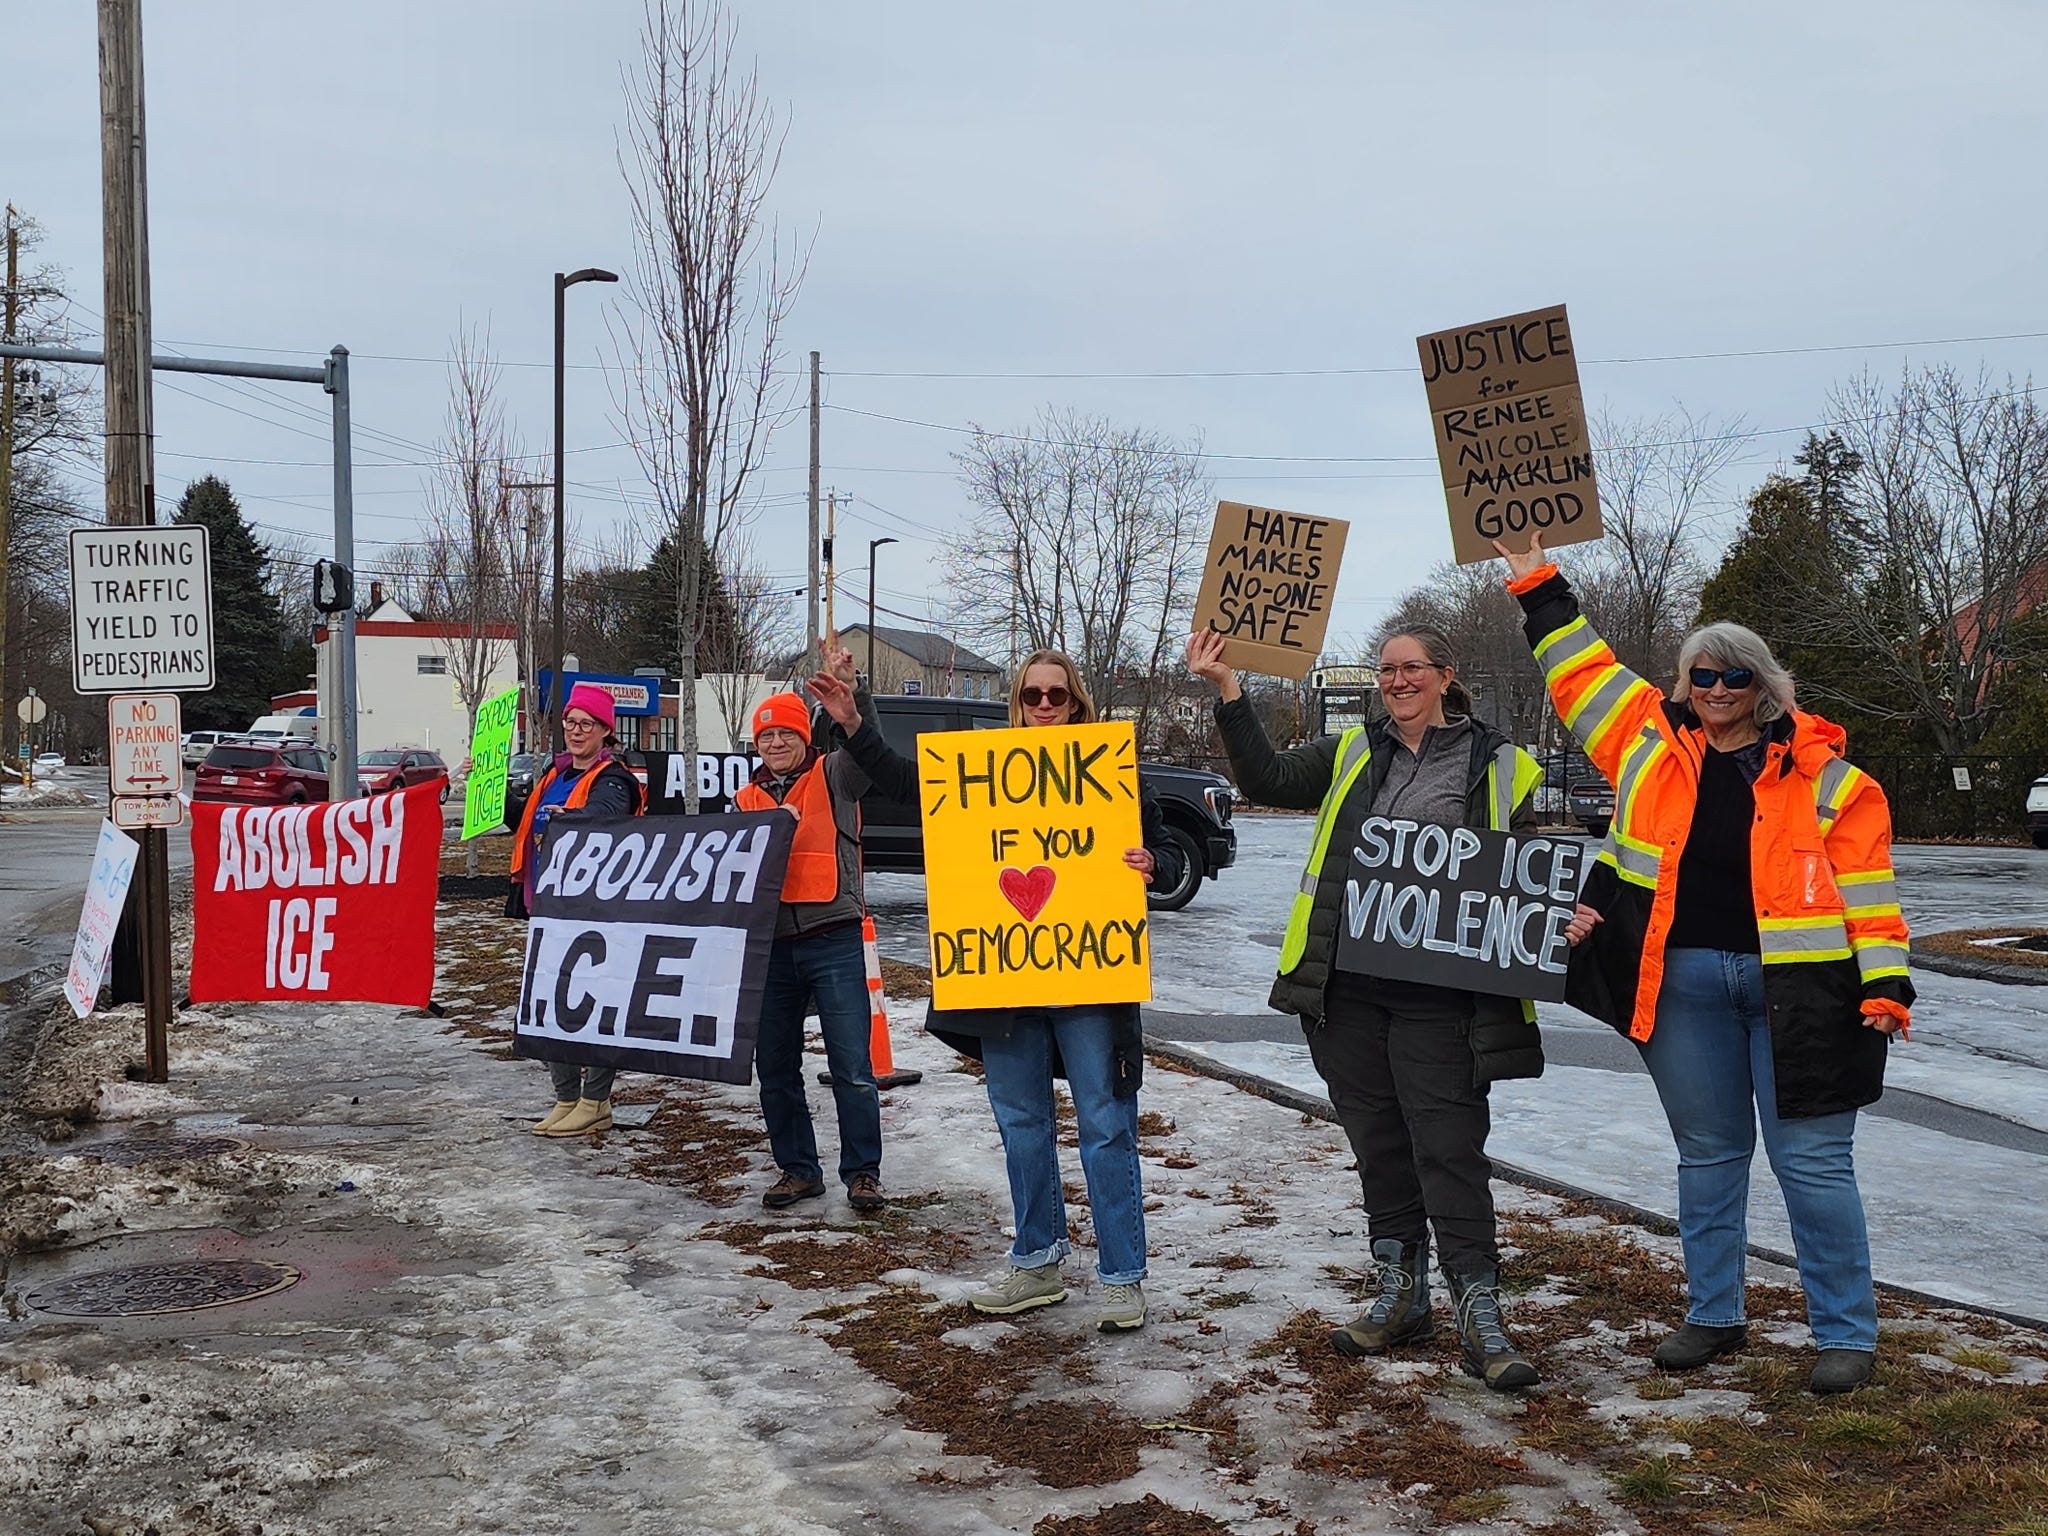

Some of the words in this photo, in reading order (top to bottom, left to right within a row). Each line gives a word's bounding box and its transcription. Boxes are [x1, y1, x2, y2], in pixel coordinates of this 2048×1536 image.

[1423, 316, 1570, 382] JUSTICE
[1478, 376, 1519, 398] for
[1443, 395, 1555, 442] RENEE
[1459, 422, 1570, 466] NICOLE
[1464, 452, 1592, 497] MACKLIN
[1243, 508, 1329, 551] HATE
[1474, 492, 1583, 539] GOOD
[84, 541, 193, 568] TURNING
[1218, 543, 1322, 580] MAKES
[91, 578, 190, 604] TRAFFIC
[1220, 570, 1329, 612] NO-ONE
[86, 615, 157, 640] YIELD
[170, 613, 198, 637] TO
[1209, 597, 1310, 648] SAFE
[82, 649, 205, 677] PEDESTRIANS
[131, 703, 157, 722] NO
[476, 691, 518, 736] EXPOSE
[614, 687, 644, 699] CLEANERS
[115, 725, 175, 744] PARKING
[133, 745, 159, 758] ANY
[131, 760, 162, 773] TIME
[664, 754, 763, 798] ABO
[957, 741, 1113, 809] HONK
[123, 801, 172, 810] TOW-AWAY
[136, 813, 161, 821] ZONE
[473, 774, 504, 827] ICE
[213, 792, 406, 892] ABOLISH
[535, 825, 771, 903] ABOLISH
[991, 829, 1019, 862] IF
[1033, 826, 1095, 861] YOU
[1353, 816, 1482, 881] STOP
[1500, 837, 1580, 902] ICE
[266, 897, 337, 990] ICE
[933, 918, 1147, 978] DEMOCRACY
[1346, 879, 1575, 974] VIOLENCE
[519, 927, 718, 1047] I.C.E.
